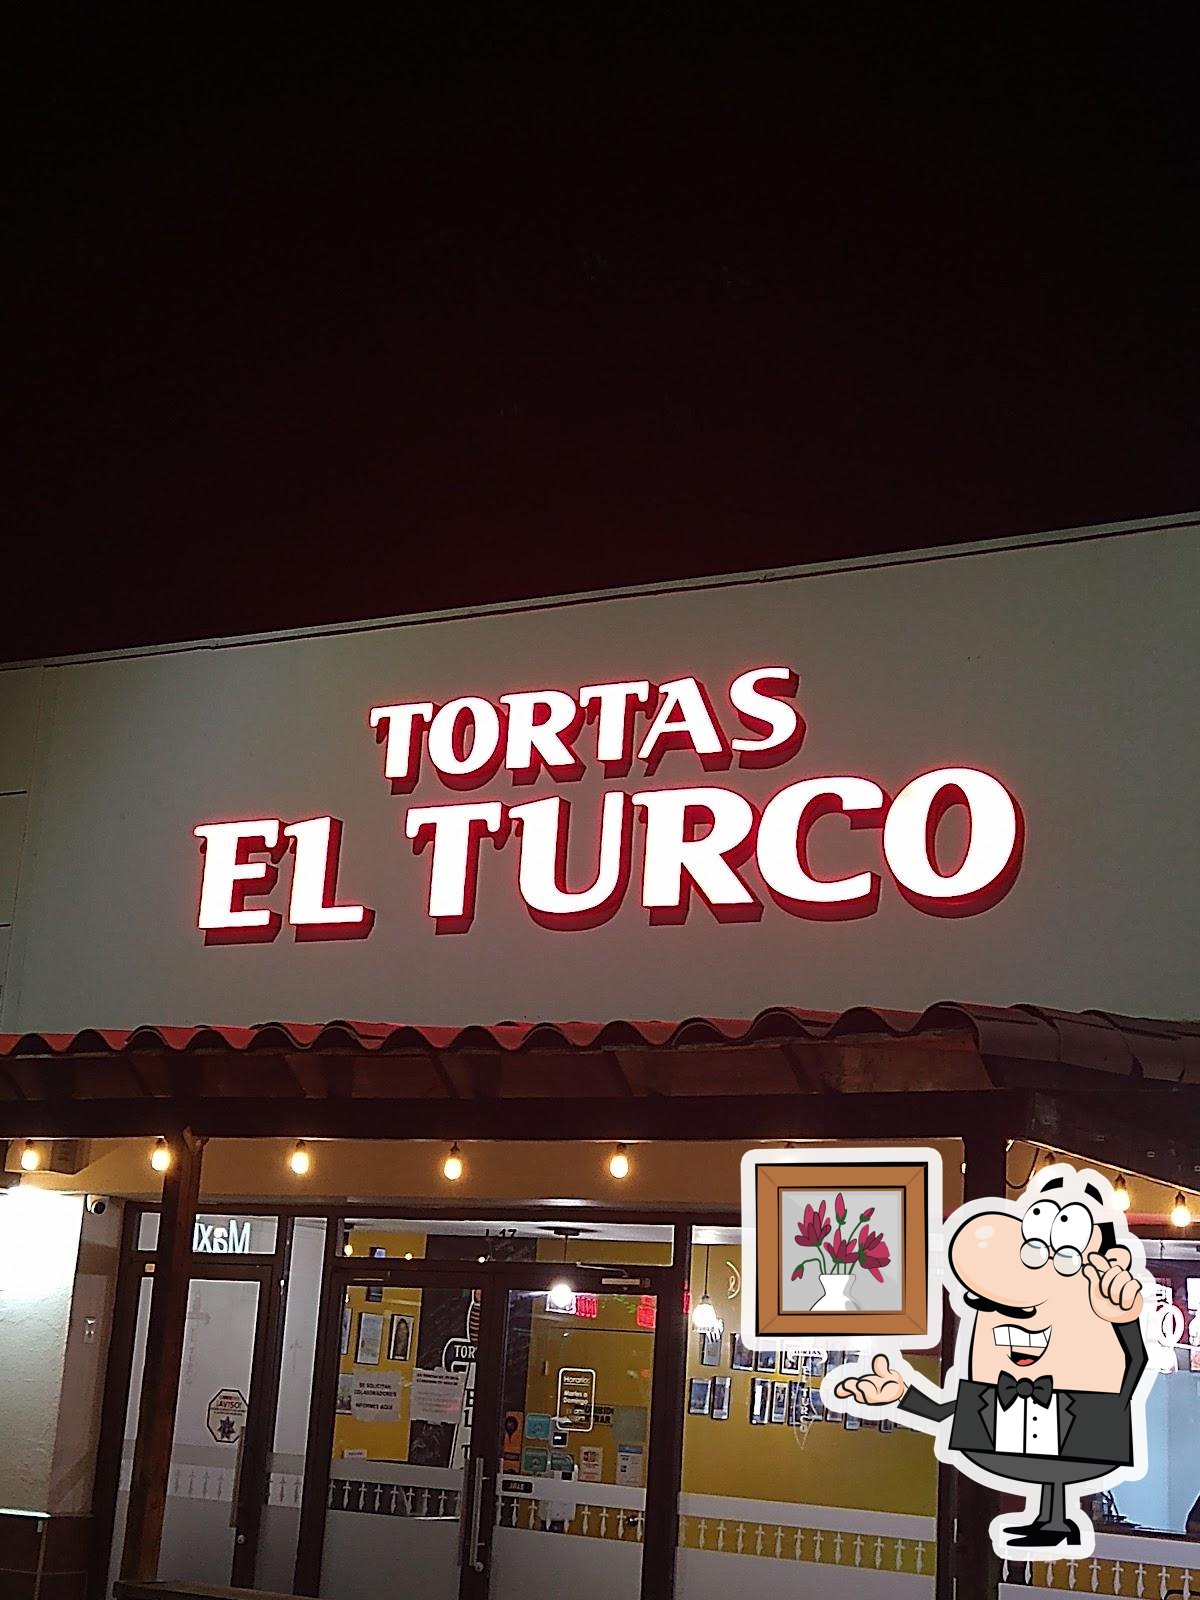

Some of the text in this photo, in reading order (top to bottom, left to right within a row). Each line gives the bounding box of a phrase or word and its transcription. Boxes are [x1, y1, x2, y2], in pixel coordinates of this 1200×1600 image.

[369, 667, 804, 792] TORTAS
[193, 767, 1024, 944] EL TURCO
[454, 1345, 477, 1359] TOR
